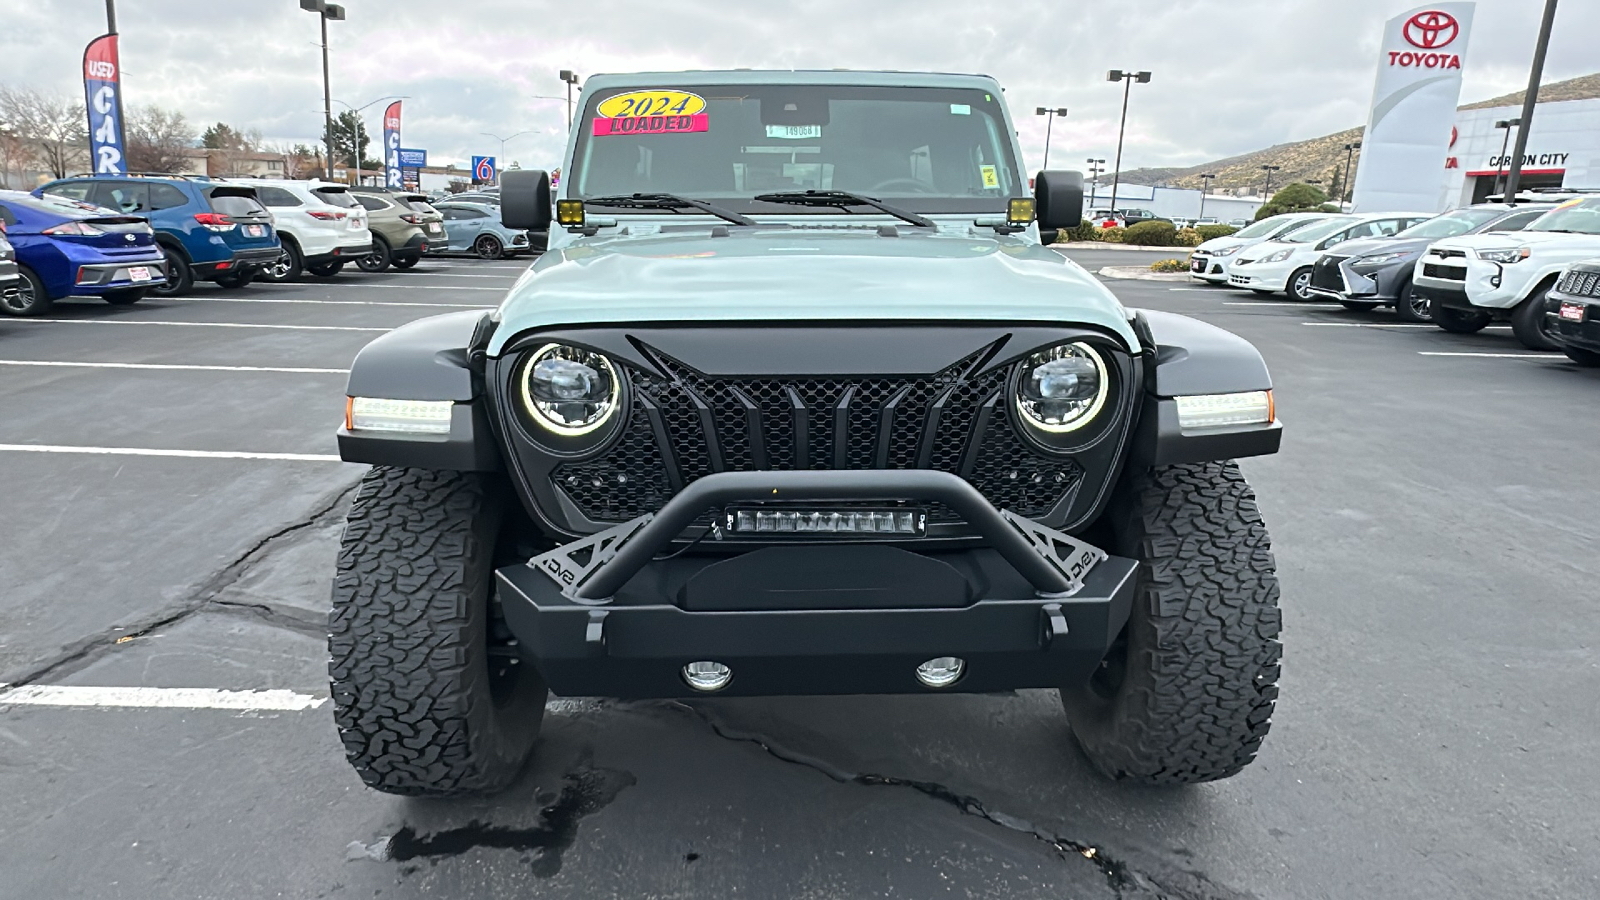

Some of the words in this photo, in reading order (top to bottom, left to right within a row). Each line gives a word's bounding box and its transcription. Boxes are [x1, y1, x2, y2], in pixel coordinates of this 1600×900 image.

[89, 60, 115, 79] USED
[1388, 51, 1460, 69] TOYOTA
[615, 96, 691, 117] 2024
[94, 86, 120, 177] CAR
[610, 116, 693, 132] LOADED
[388, 132, 402, 188] CAR
[476, 157, 493, 181] 6
[1540, 153, 1569, 165] CITY
